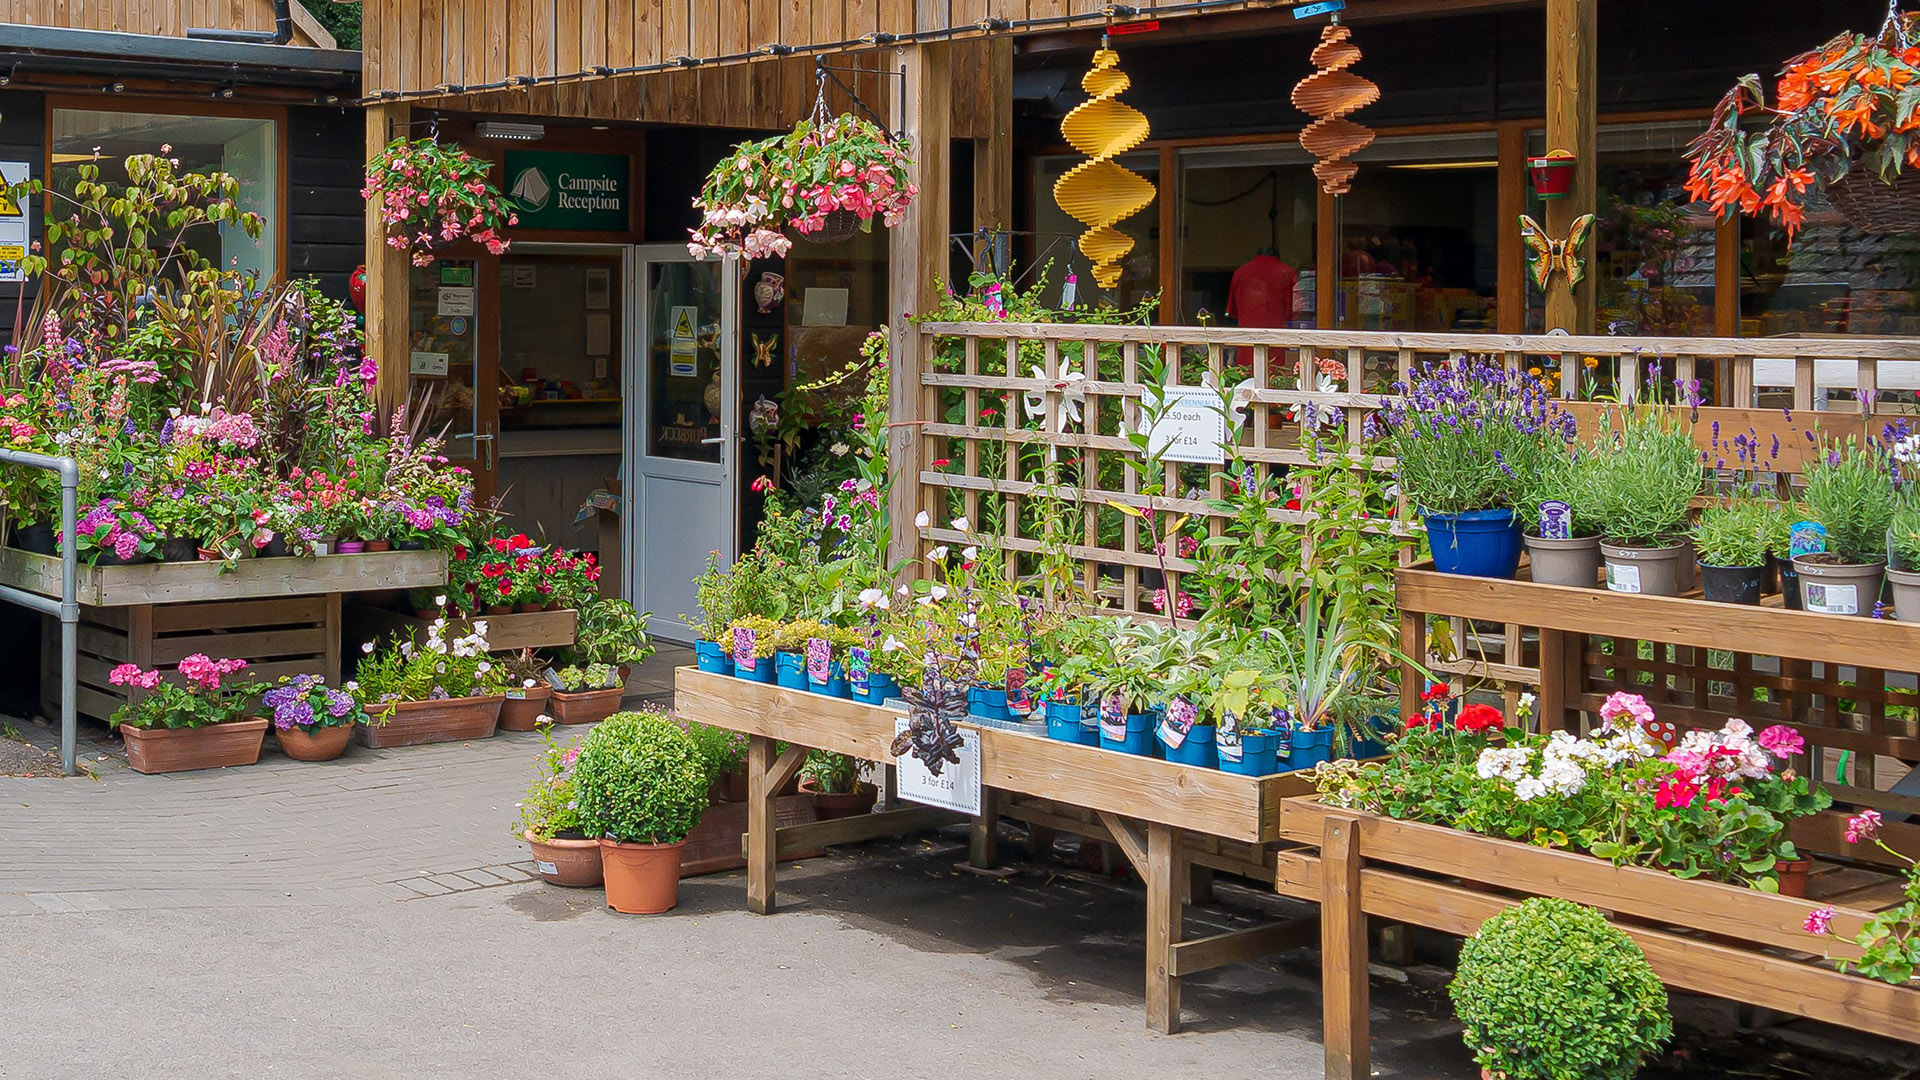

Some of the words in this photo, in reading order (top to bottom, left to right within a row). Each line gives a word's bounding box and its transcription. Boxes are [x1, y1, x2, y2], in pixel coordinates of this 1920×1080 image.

[558, 173, 617, 194] Campsite
[558, 192, 620, 212] Reception
[1183, 412, 1201, 421] each
[1165, 435, 1170, 443] 3
[1184, 436, 1198, 445] £14
[921, 775, 927, 785] 3
[928, 776, 939, 787] for
[940, 779, 955, 790] £14
